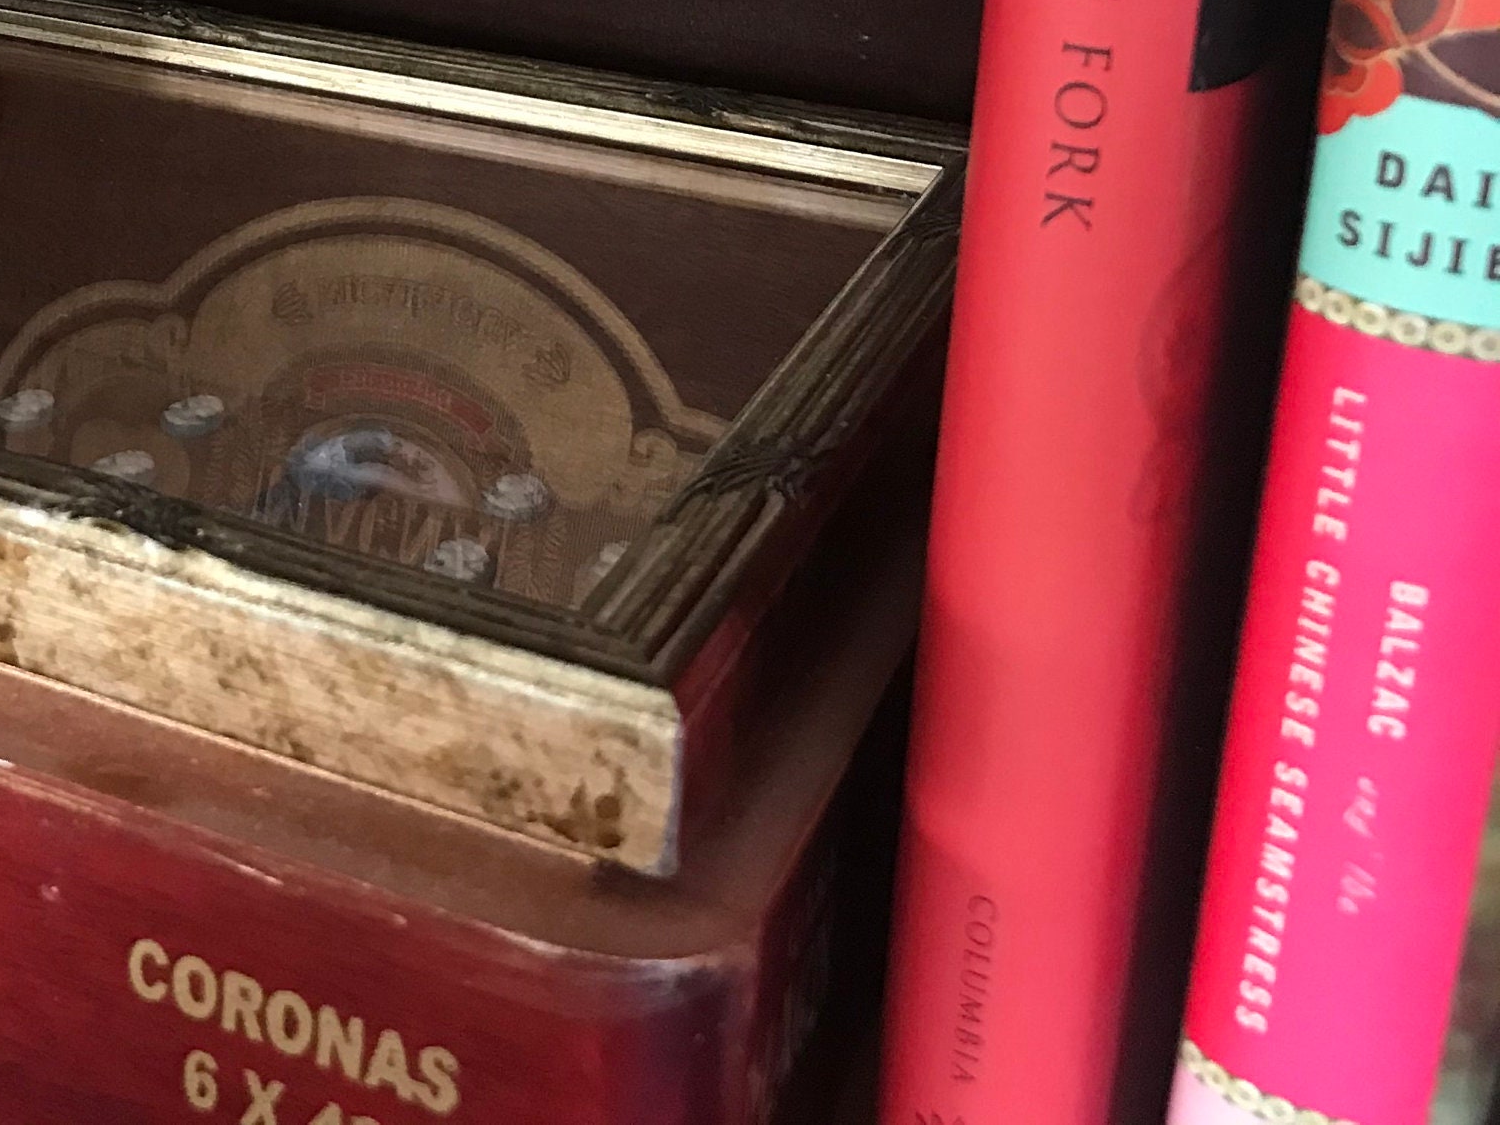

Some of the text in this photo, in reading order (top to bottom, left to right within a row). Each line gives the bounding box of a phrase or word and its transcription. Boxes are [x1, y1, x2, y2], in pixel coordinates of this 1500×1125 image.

[1038, 39, 1115, 232] FORK
[1376, 150, 1498, 209] DAI
[1235, 385, 1368, 1035] LITTLE CHINESE SEAMSTRESS
[1366, 579, 1430, 740] BALZAC
[128, 938, 462, 1114] CORONAS
[951, 894, 997, 1082] COLUMBIA
[183, 1049, 219, 1111] 6
[240, 1068, 287, 1125] X
